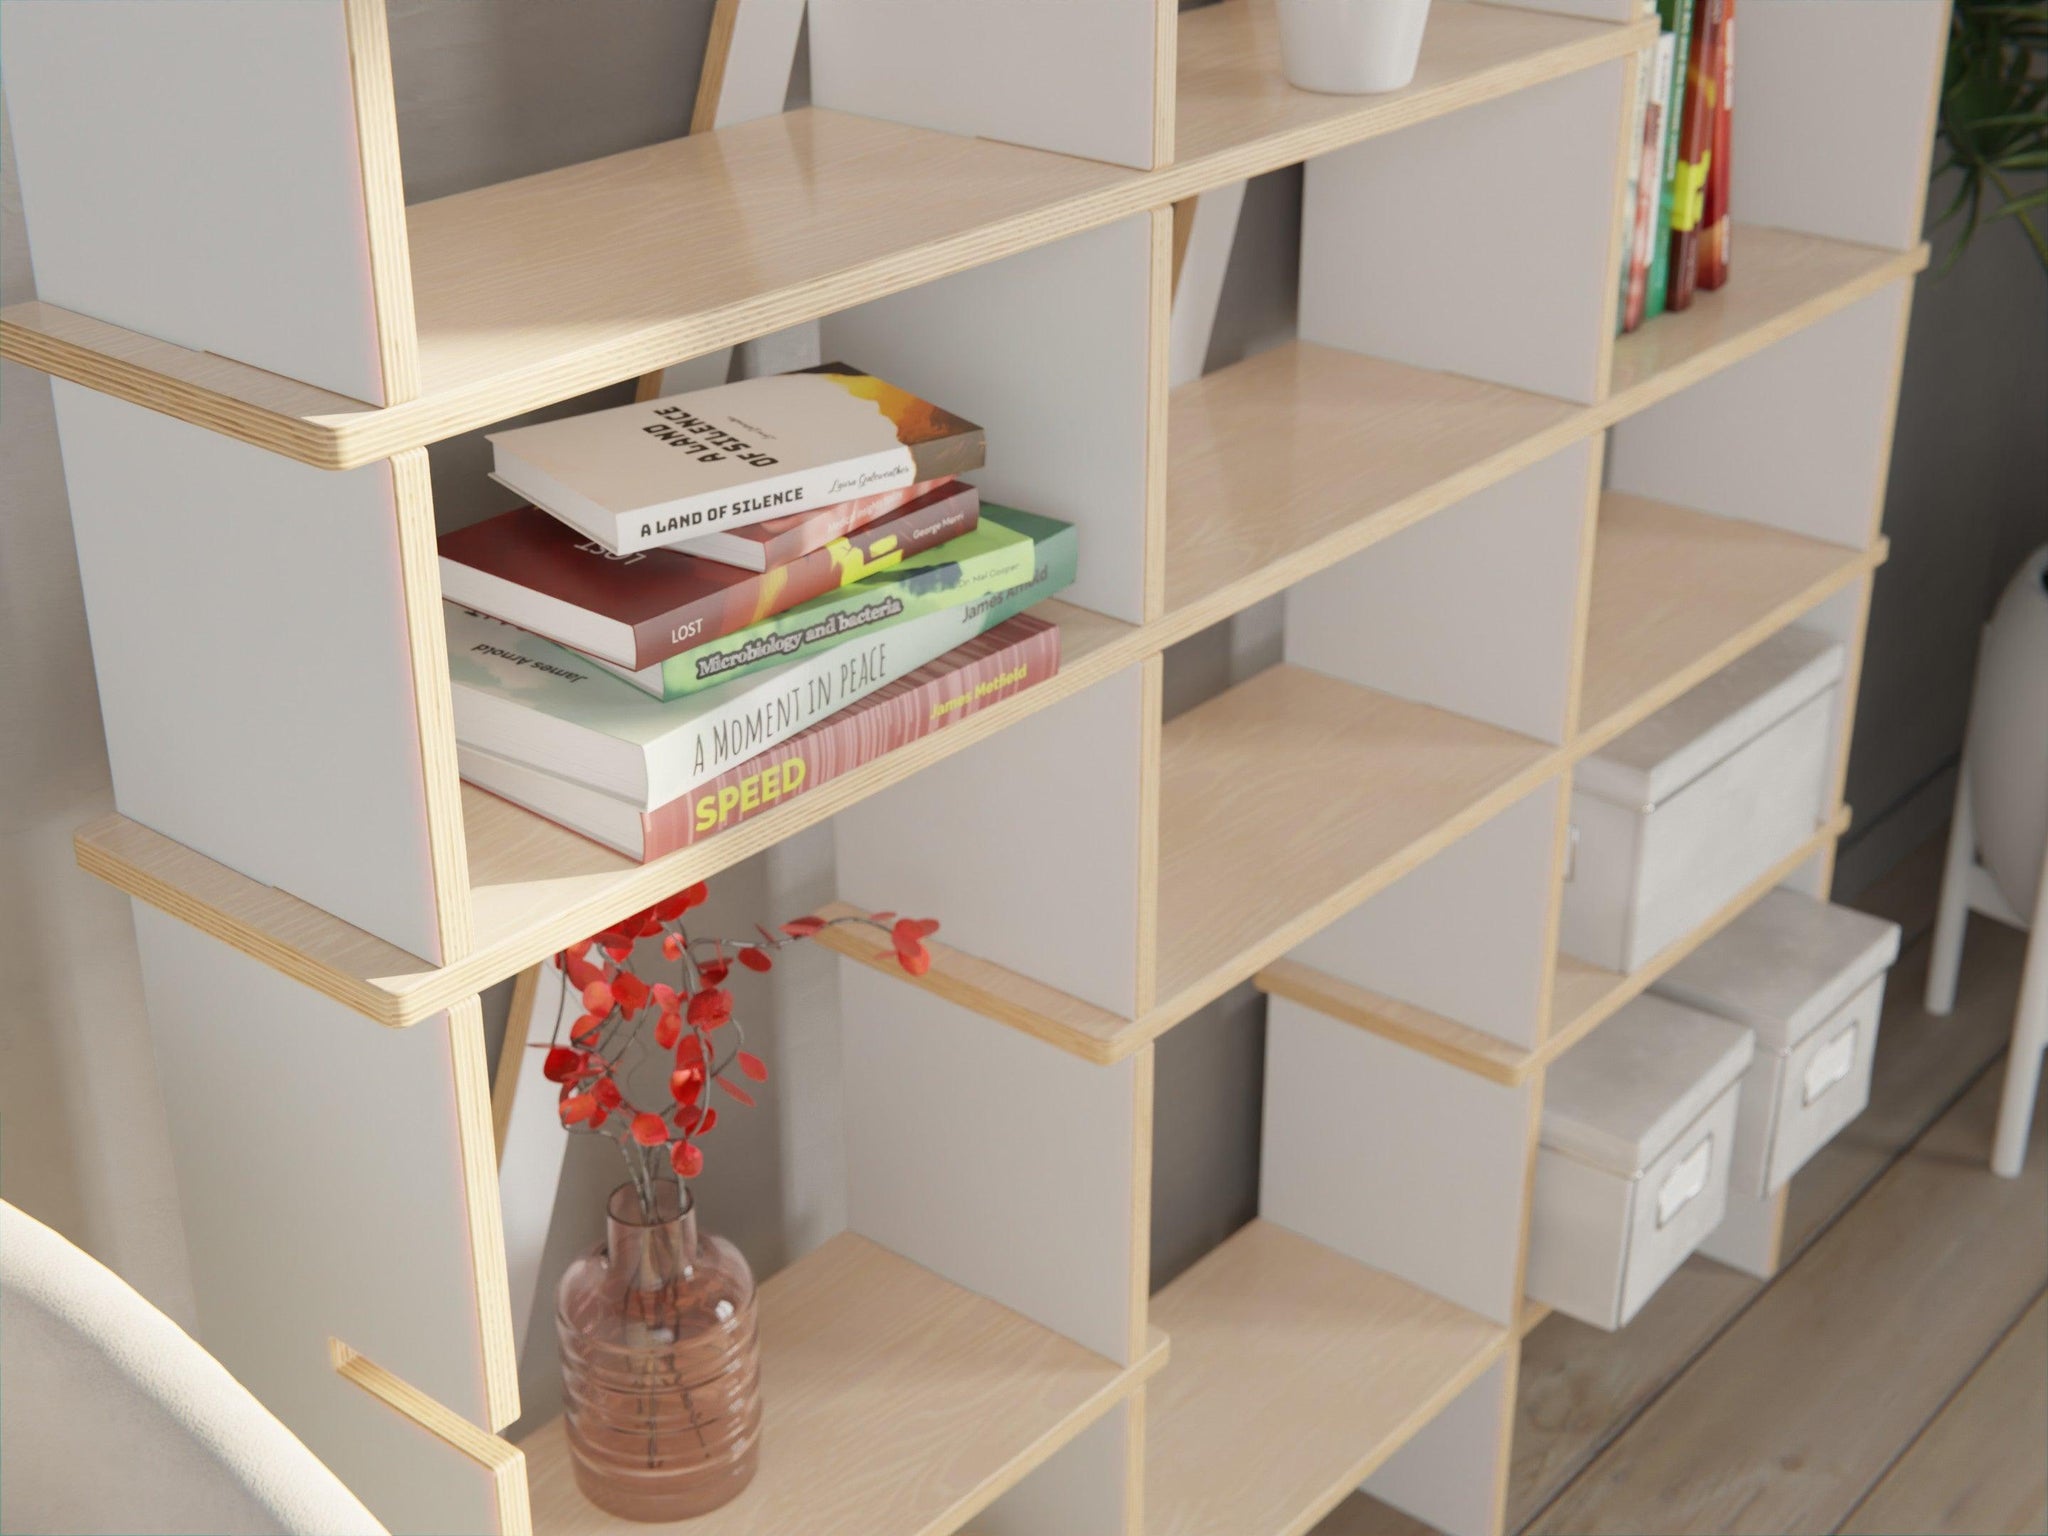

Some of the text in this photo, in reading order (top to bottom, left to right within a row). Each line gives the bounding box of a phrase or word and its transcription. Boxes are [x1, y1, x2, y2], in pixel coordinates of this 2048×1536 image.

[642, 424, 709, 455] LAND
[653, 406, 751, 452] SILENCE
[697, 452, 727, 462] A
[736, 452, 779, 467] OF
[641, 487, 804, 537] A LAND OF SILENCE
[962, 592, 1004, 623] James
[671, 618, 704, 644] LOST
[696, 596, 904, 680] Microbiology and bacteria
[472, 643, 588, 683] James Arnold
[693, 643, 887, 776] A MOMENT IN PEACE
[930, 692, 973, 720] James
[695, 757, 806, 832] SPEED
